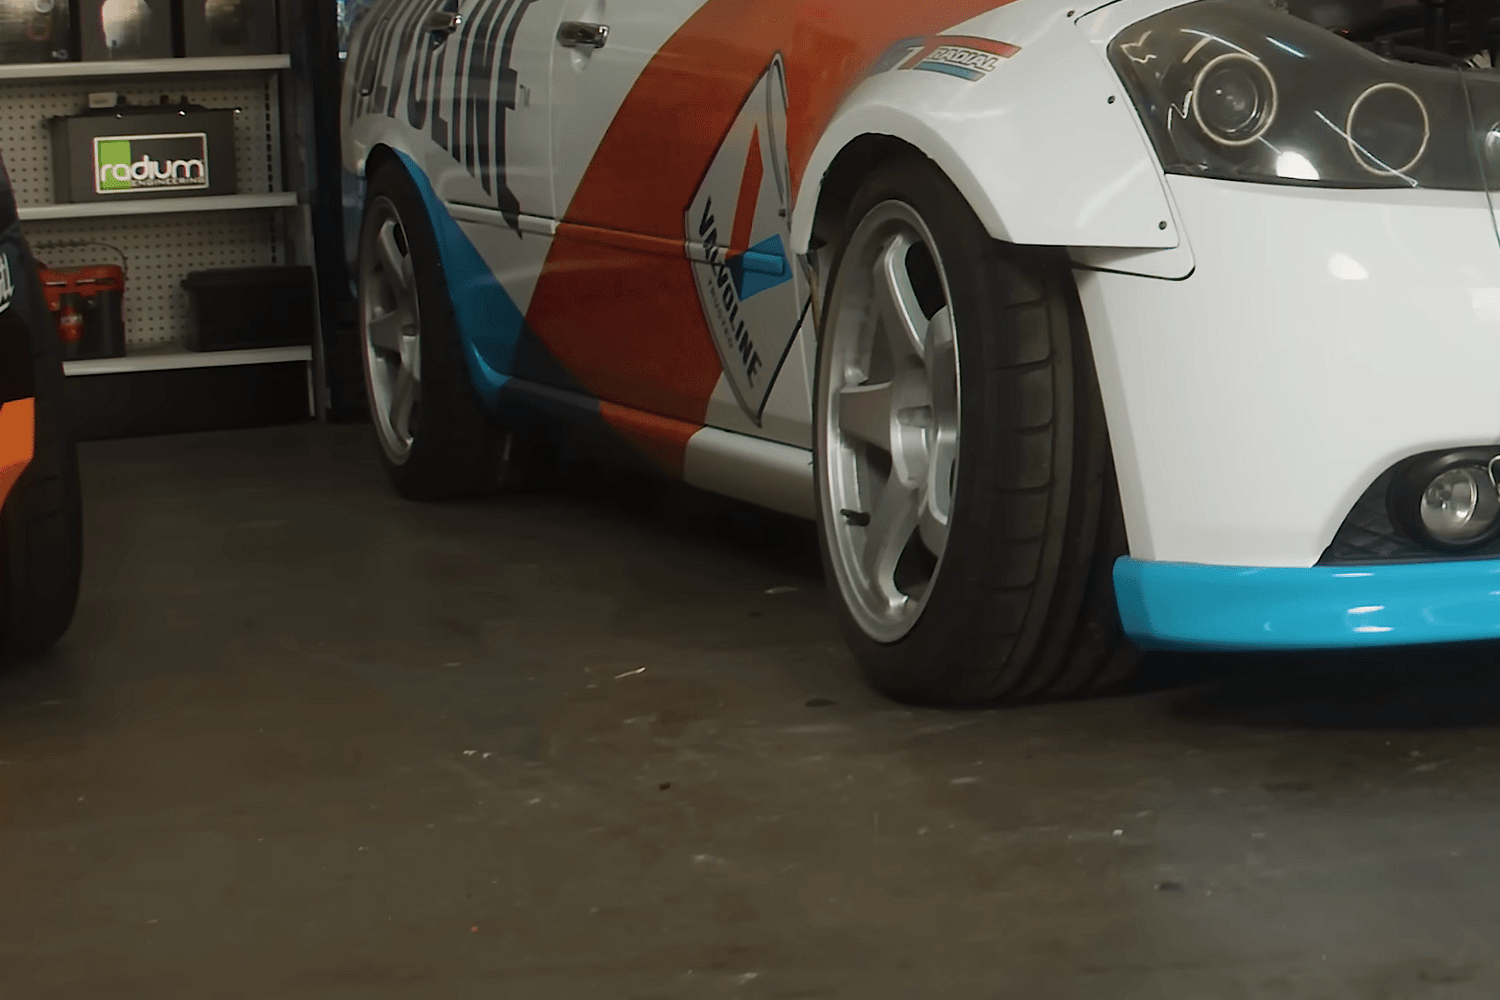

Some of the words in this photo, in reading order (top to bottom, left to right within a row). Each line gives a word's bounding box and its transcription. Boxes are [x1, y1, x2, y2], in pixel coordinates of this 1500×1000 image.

[926, 46, 999, 73] RADIAL
[100, 154, 204, 182] radium
[698, 195, 763, 389] VALVOLINE
